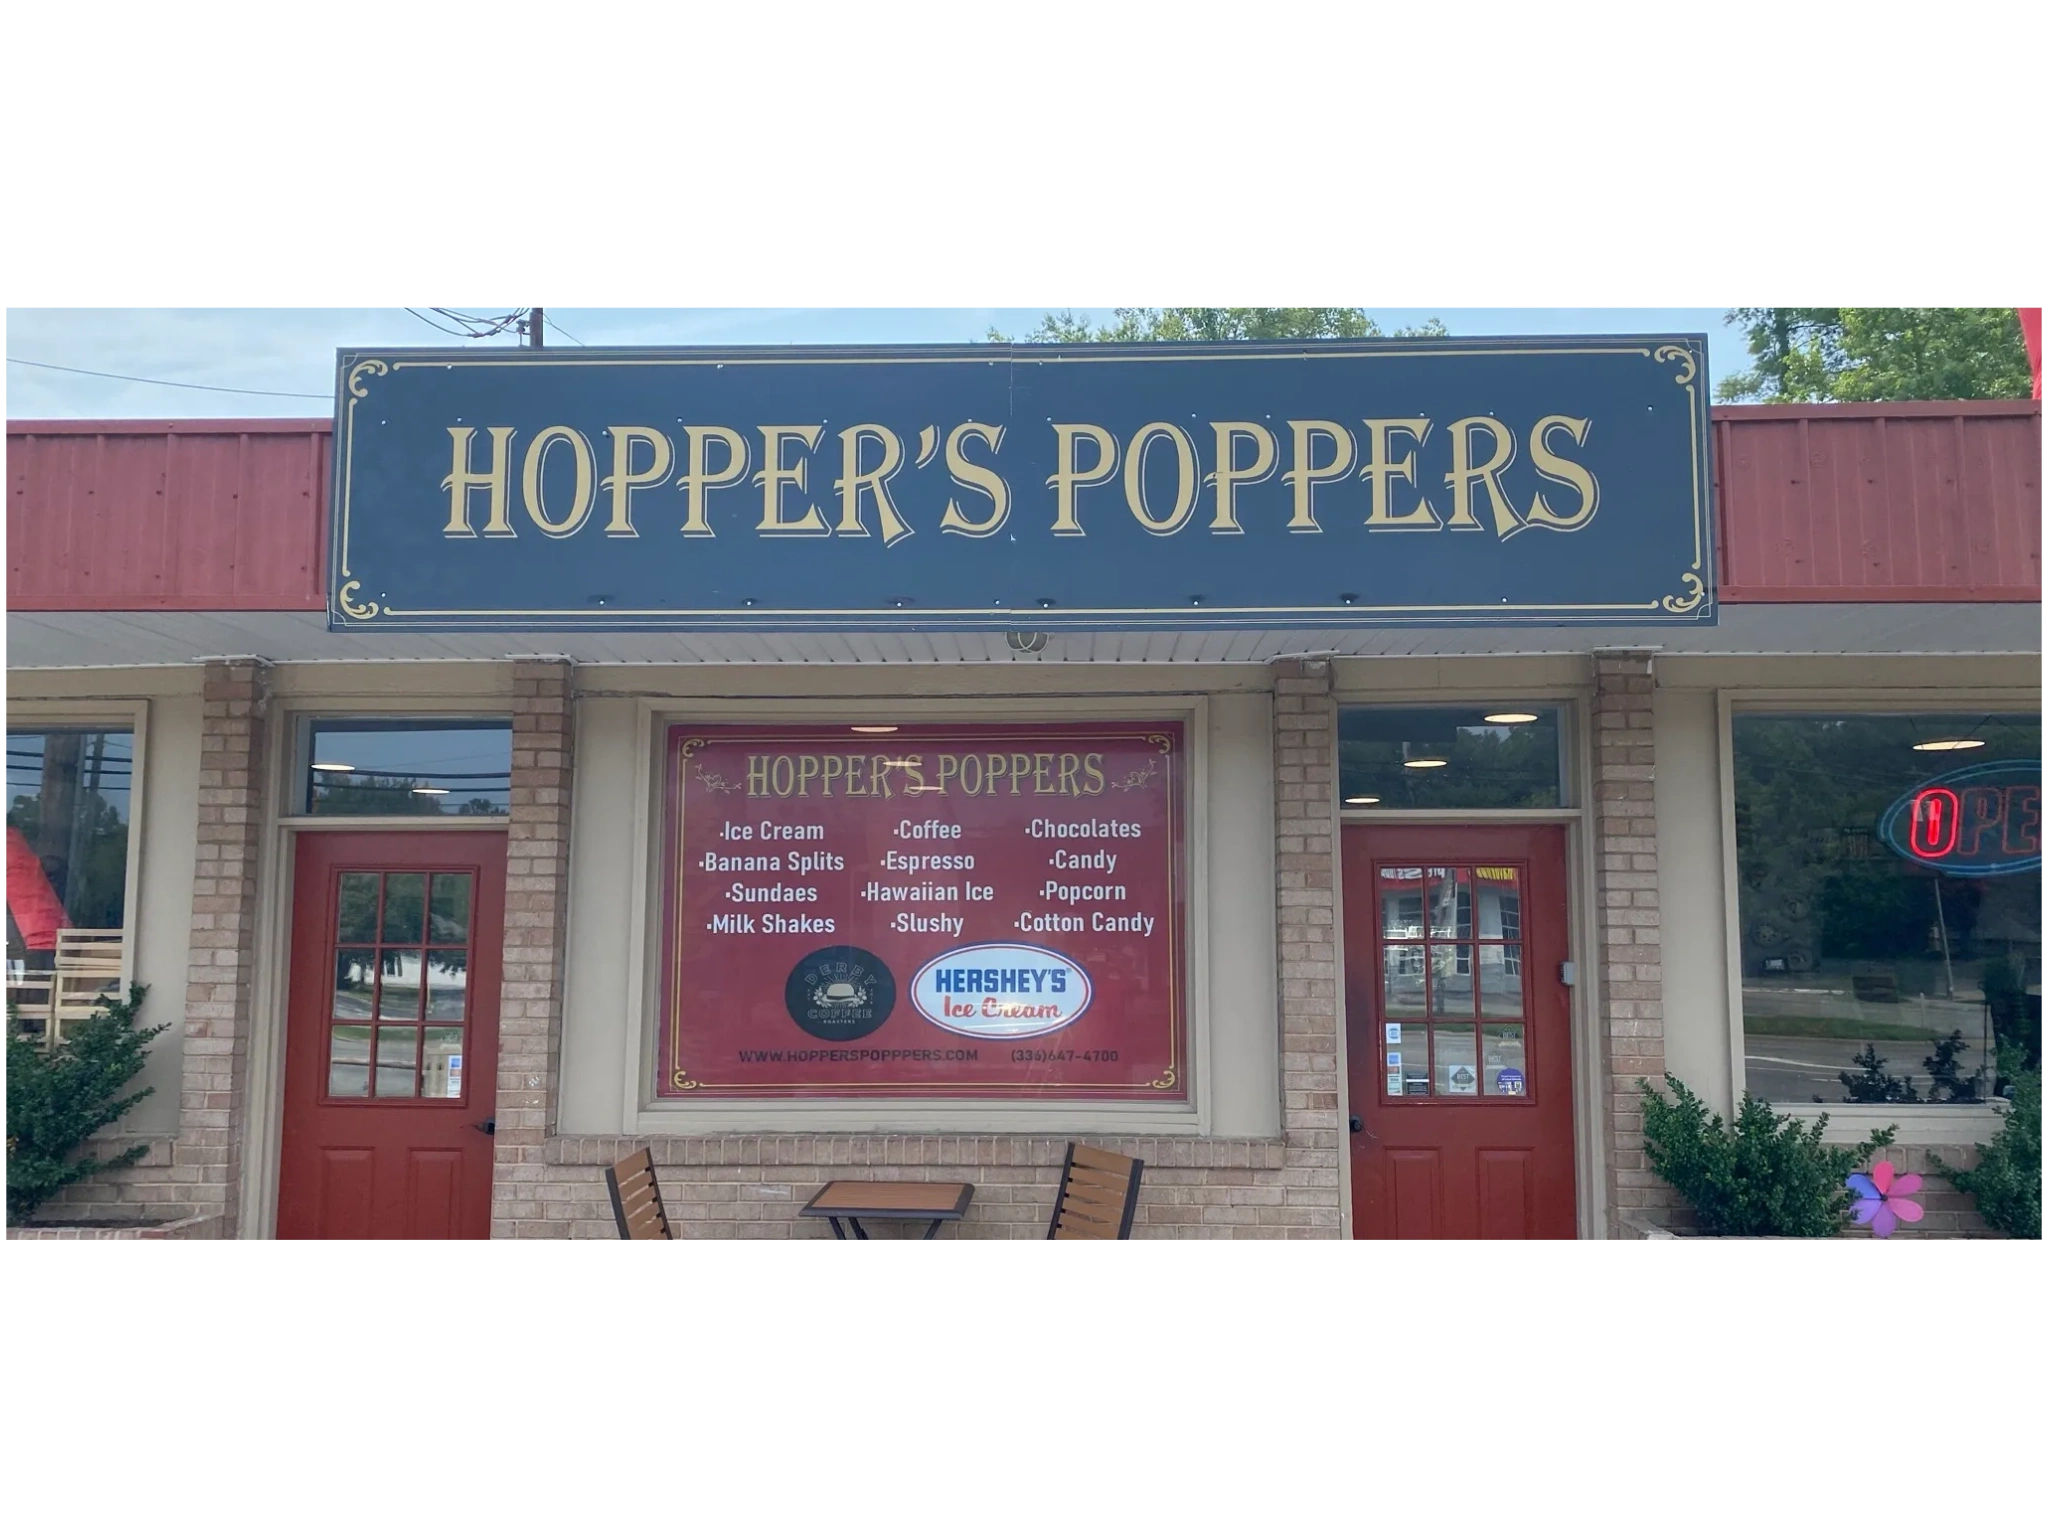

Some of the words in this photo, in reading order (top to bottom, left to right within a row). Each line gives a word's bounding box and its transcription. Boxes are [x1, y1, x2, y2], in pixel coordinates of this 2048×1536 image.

[440, 423, 1012, 548] HOPPER'S
[1045, 415, 1600, 542] POPPERS
[747, 755, 925, 799] HOPPER'S
[937, 753, 1105, 799] POPPERS
[725, 821, 753, 840] Ice
[760, 821, 824, 840] Cream
[900, 820, 961, 839] Coffee
[1031, 818, 1141, 838] Chocolates
[1910, 785, 2042, 858] OPE
[705, 852, 780, 871] Banana
[788, 851, 844, 876] Splits
[887, 851, 975, 875] Espresso
[1055, 849, 1117, 874] Candy
[732, 882, 817, 902] Sundaes
[867, 881, 958, 901] Hawaiian
[966, 881, 993, 900] Ice
[1046, 881, 1126, 905] Popcorn
[713, 914, 756, 933] Milk
[762, 913, 835, 933] Shakes
[897, 912, 964, 937] Slushy
[1020, 911, 1084, 932] Cotton
[1092, 911, 1154, 937] Candy
[804, 962, 877, 985] DERBY
[936, 969, 1066, 993] HERSHEY'S
[807, 1008, 873, 1019] COFFEE
[944, 995, 976, 1017] Ice
[982, 997, 1063, 1018] Cream
[739, 1050, 978, 1062] WWW.HOPPERSPOPPPERS.COM
